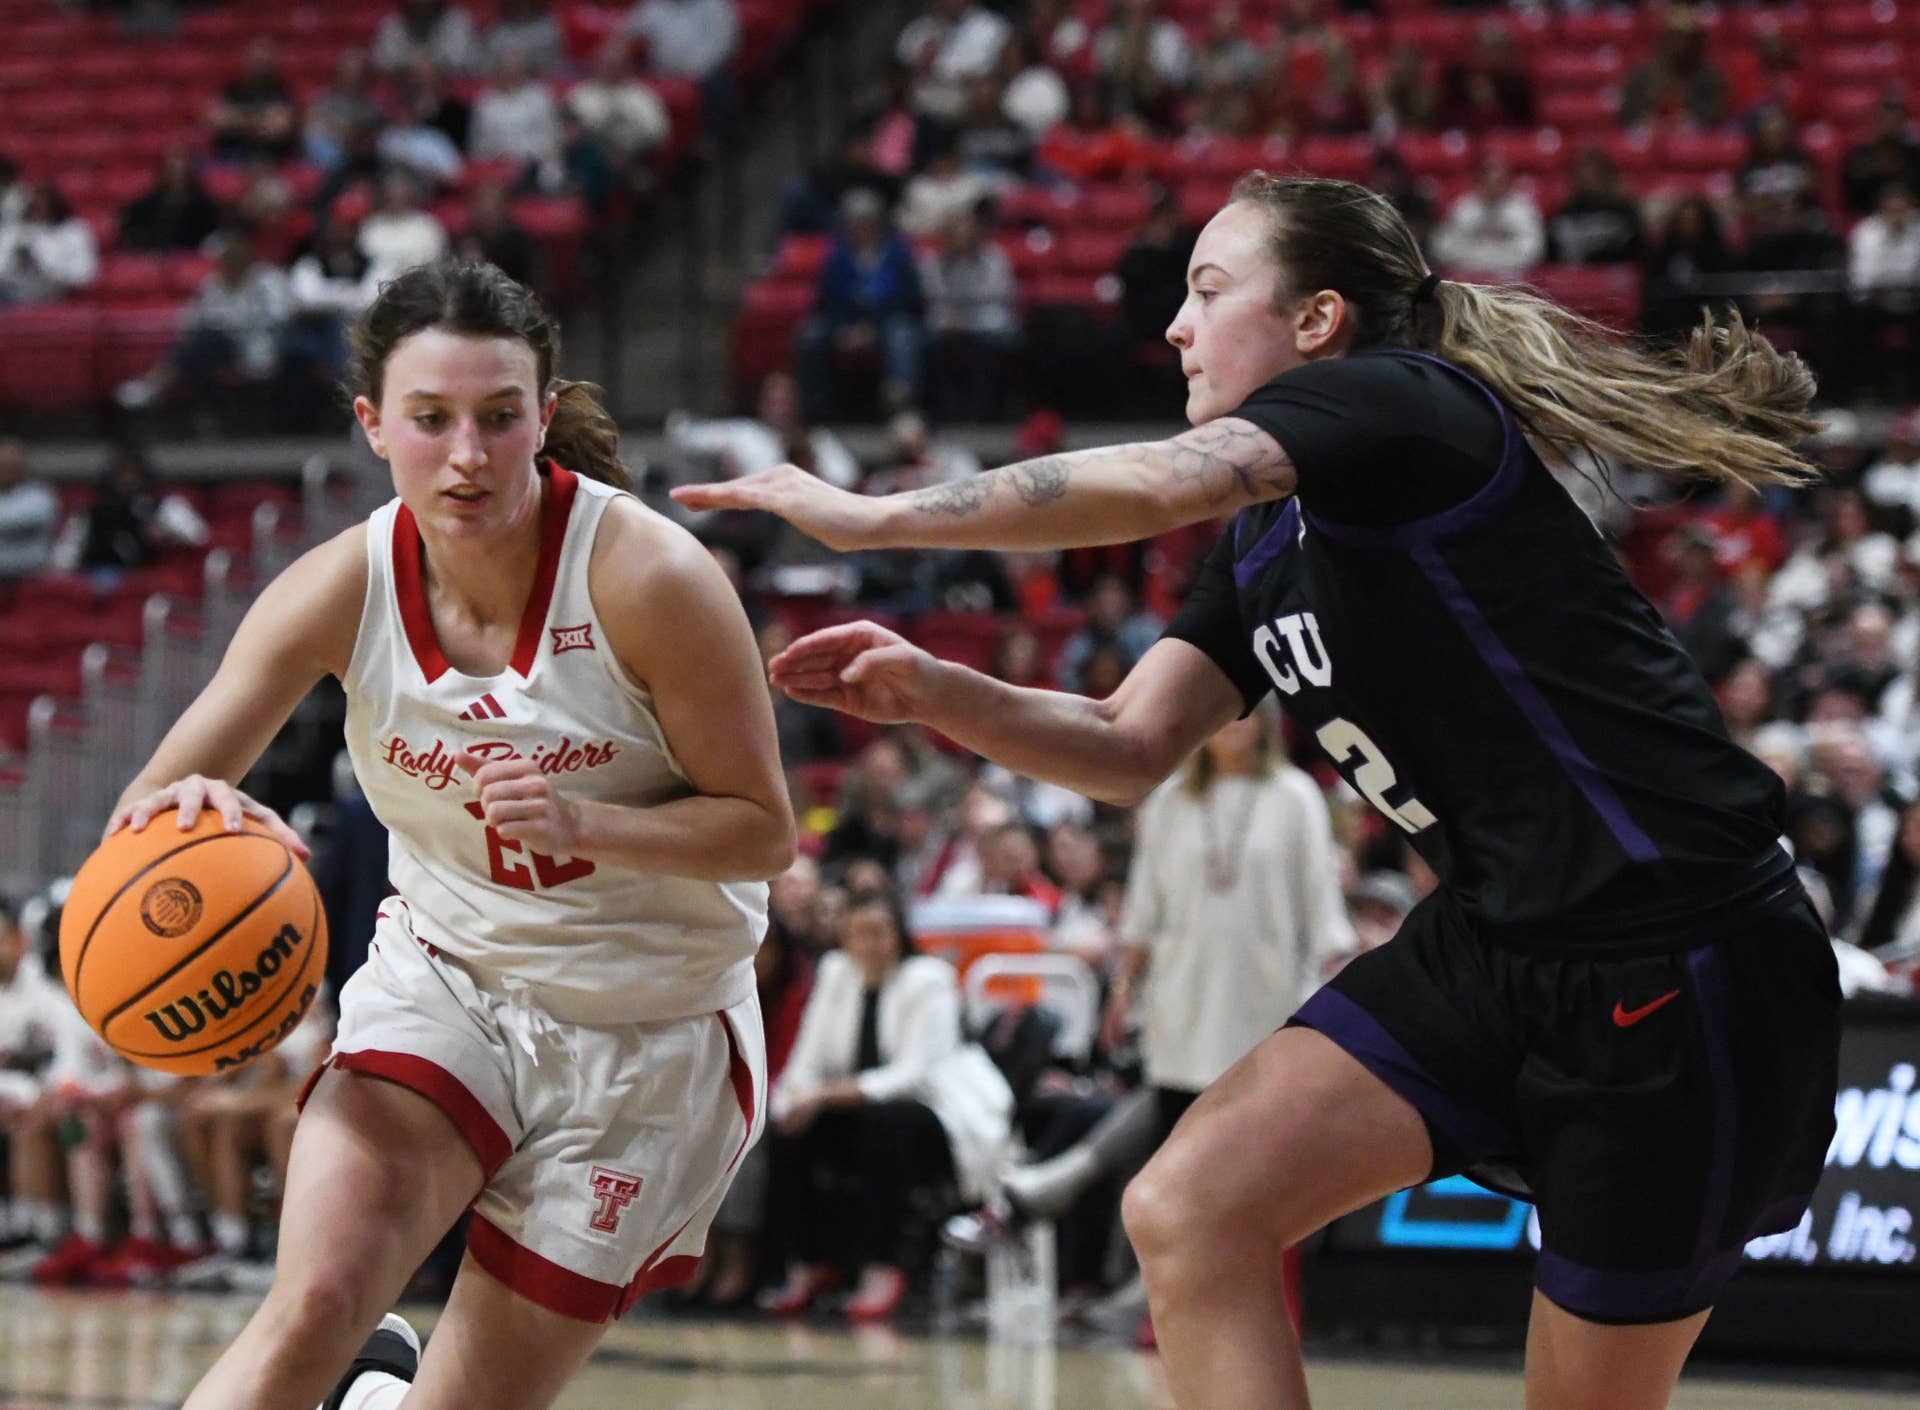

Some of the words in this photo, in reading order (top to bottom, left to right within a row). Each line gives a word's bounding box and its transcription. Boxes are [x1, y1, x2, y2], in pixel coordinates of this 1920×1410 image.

[379, 736, 461, 791] Lady
[144, 922, 303, 1042] Wilson
[1827, 1190, 1916, 1264] Inc.
